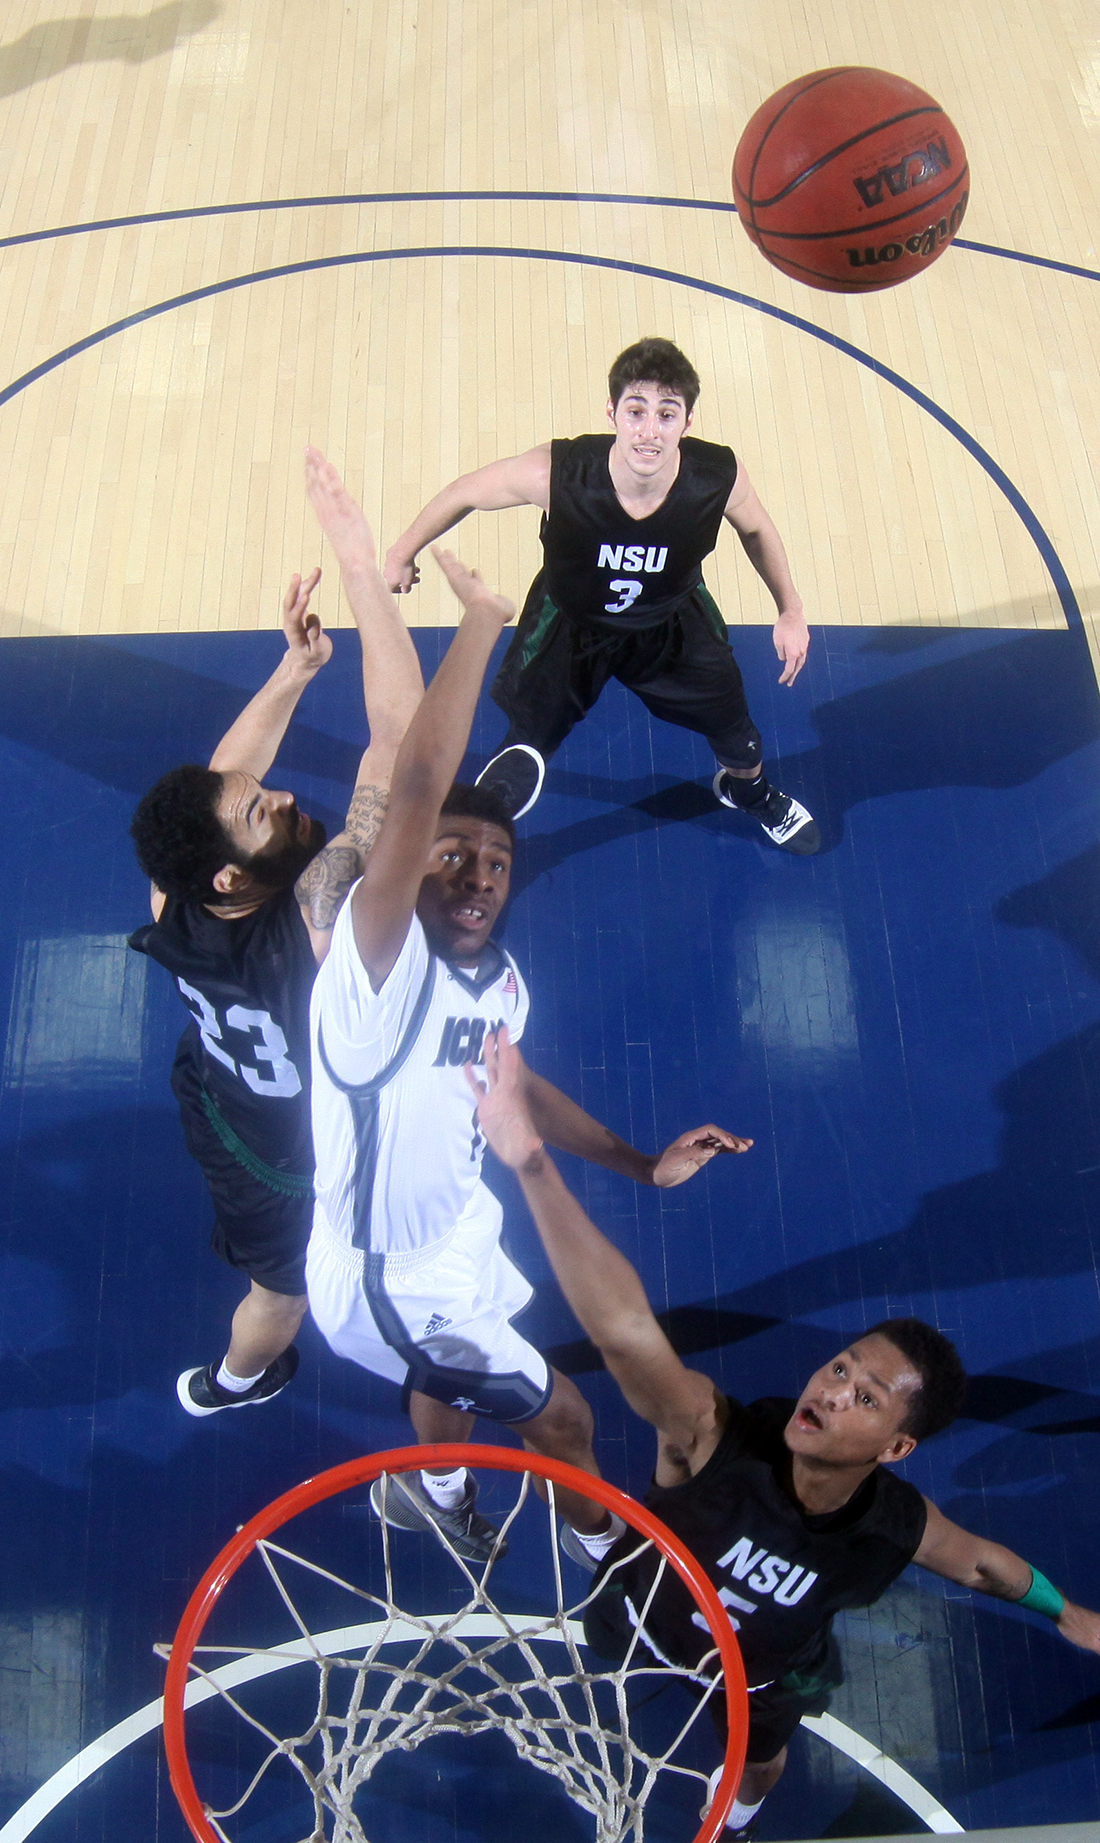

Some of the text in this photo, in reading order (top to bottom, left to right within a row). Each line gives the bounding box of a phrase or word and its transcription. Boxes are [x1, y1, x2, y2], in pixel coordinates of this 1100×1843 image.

[853, 135, 953, 209] NCAA
[597, 543, 669, 573] NSU
[604, 579, 644, 614] 3
[177, 976, 302, 1098] 23
[716, 1536, 819, 1607] NSU
